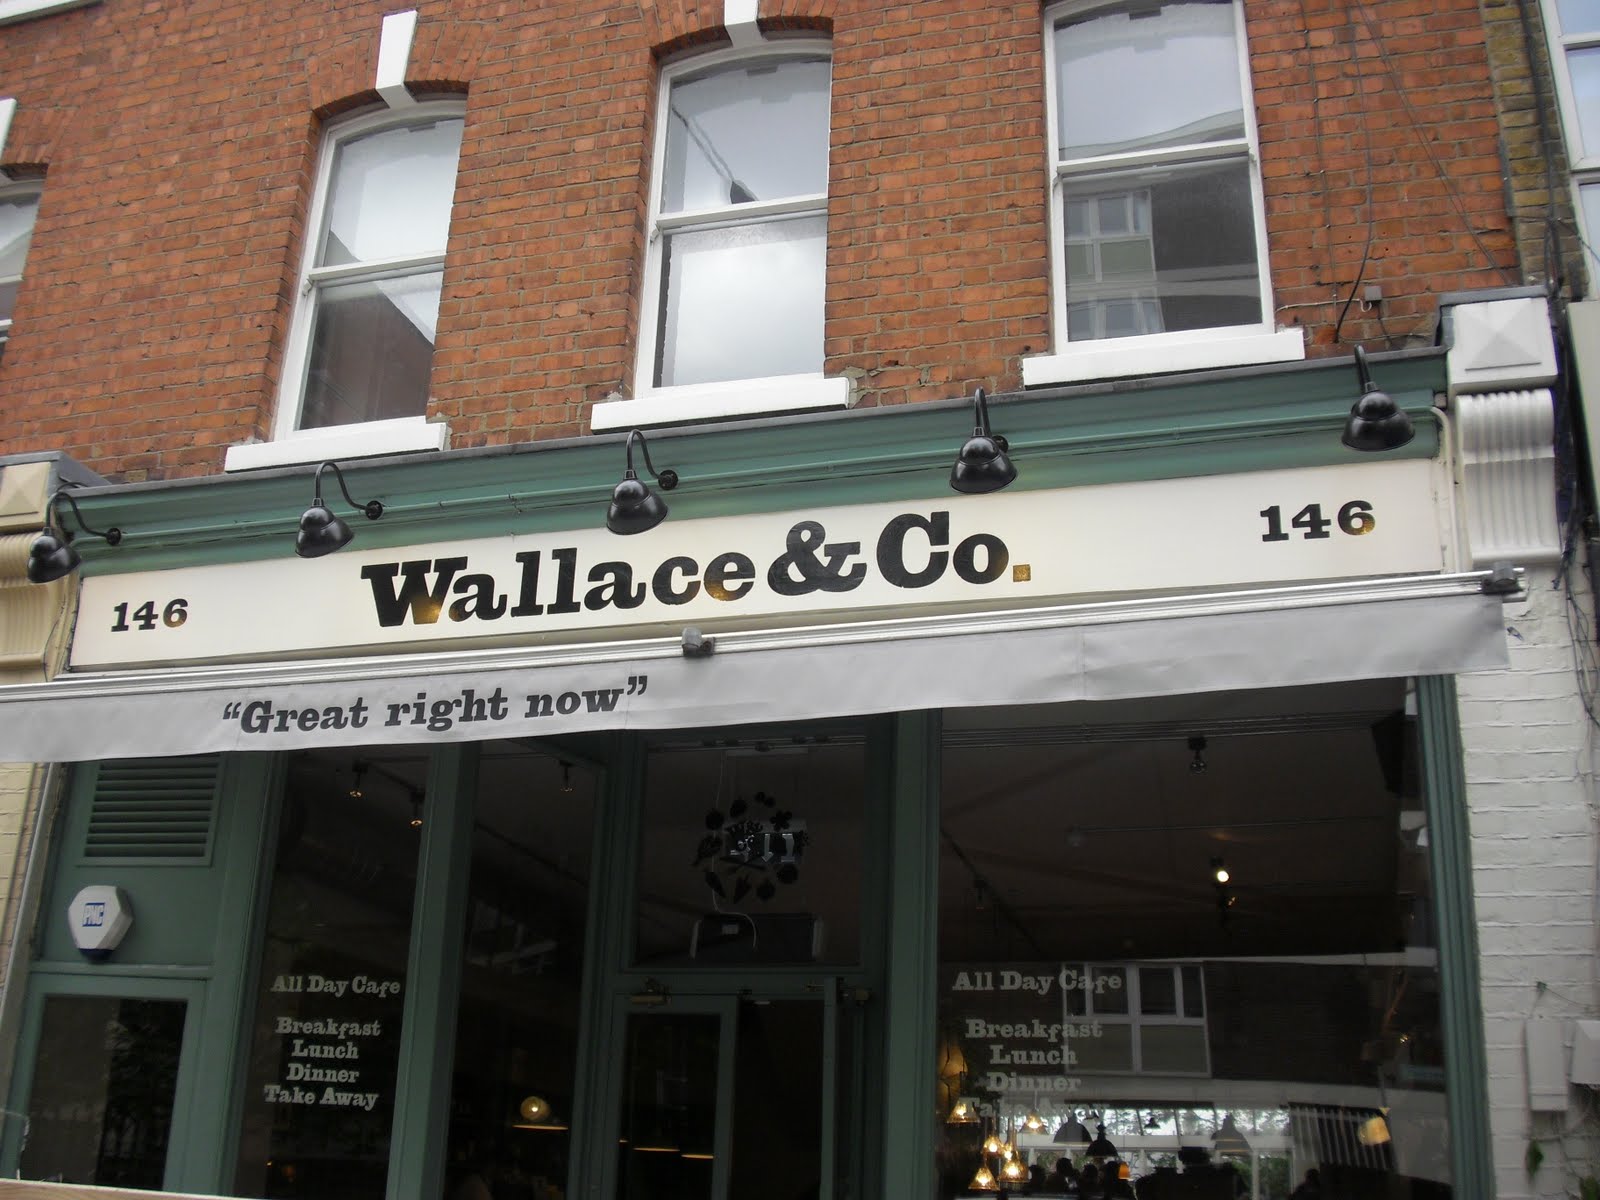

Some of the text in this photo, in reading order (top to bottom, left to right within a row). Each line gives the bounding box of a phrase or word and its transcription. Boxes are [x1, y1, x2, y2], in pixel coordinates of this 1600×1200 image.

[1260, 500, 1376, 542] 146
[111, 598, 188, 632] 146
[222, 676, 648, 733] “Great right now”
[271, 975, 400, 997] All Day Cafe
[952, 970, 1122, 995] All Day Cafe
[275, 1017, 381, 1039] Breakfast
[965, 1019, 1103, 1042] Breakfast
[291, 1040, 359, 1059] Lunch
[990, 1045, 1078, 1065] Lunch
[286, 1063, 359, 1083] Dinner
[986, 1072, 1082, 1091] Dinner
[264, 1085, 379, 1111] Take Away
